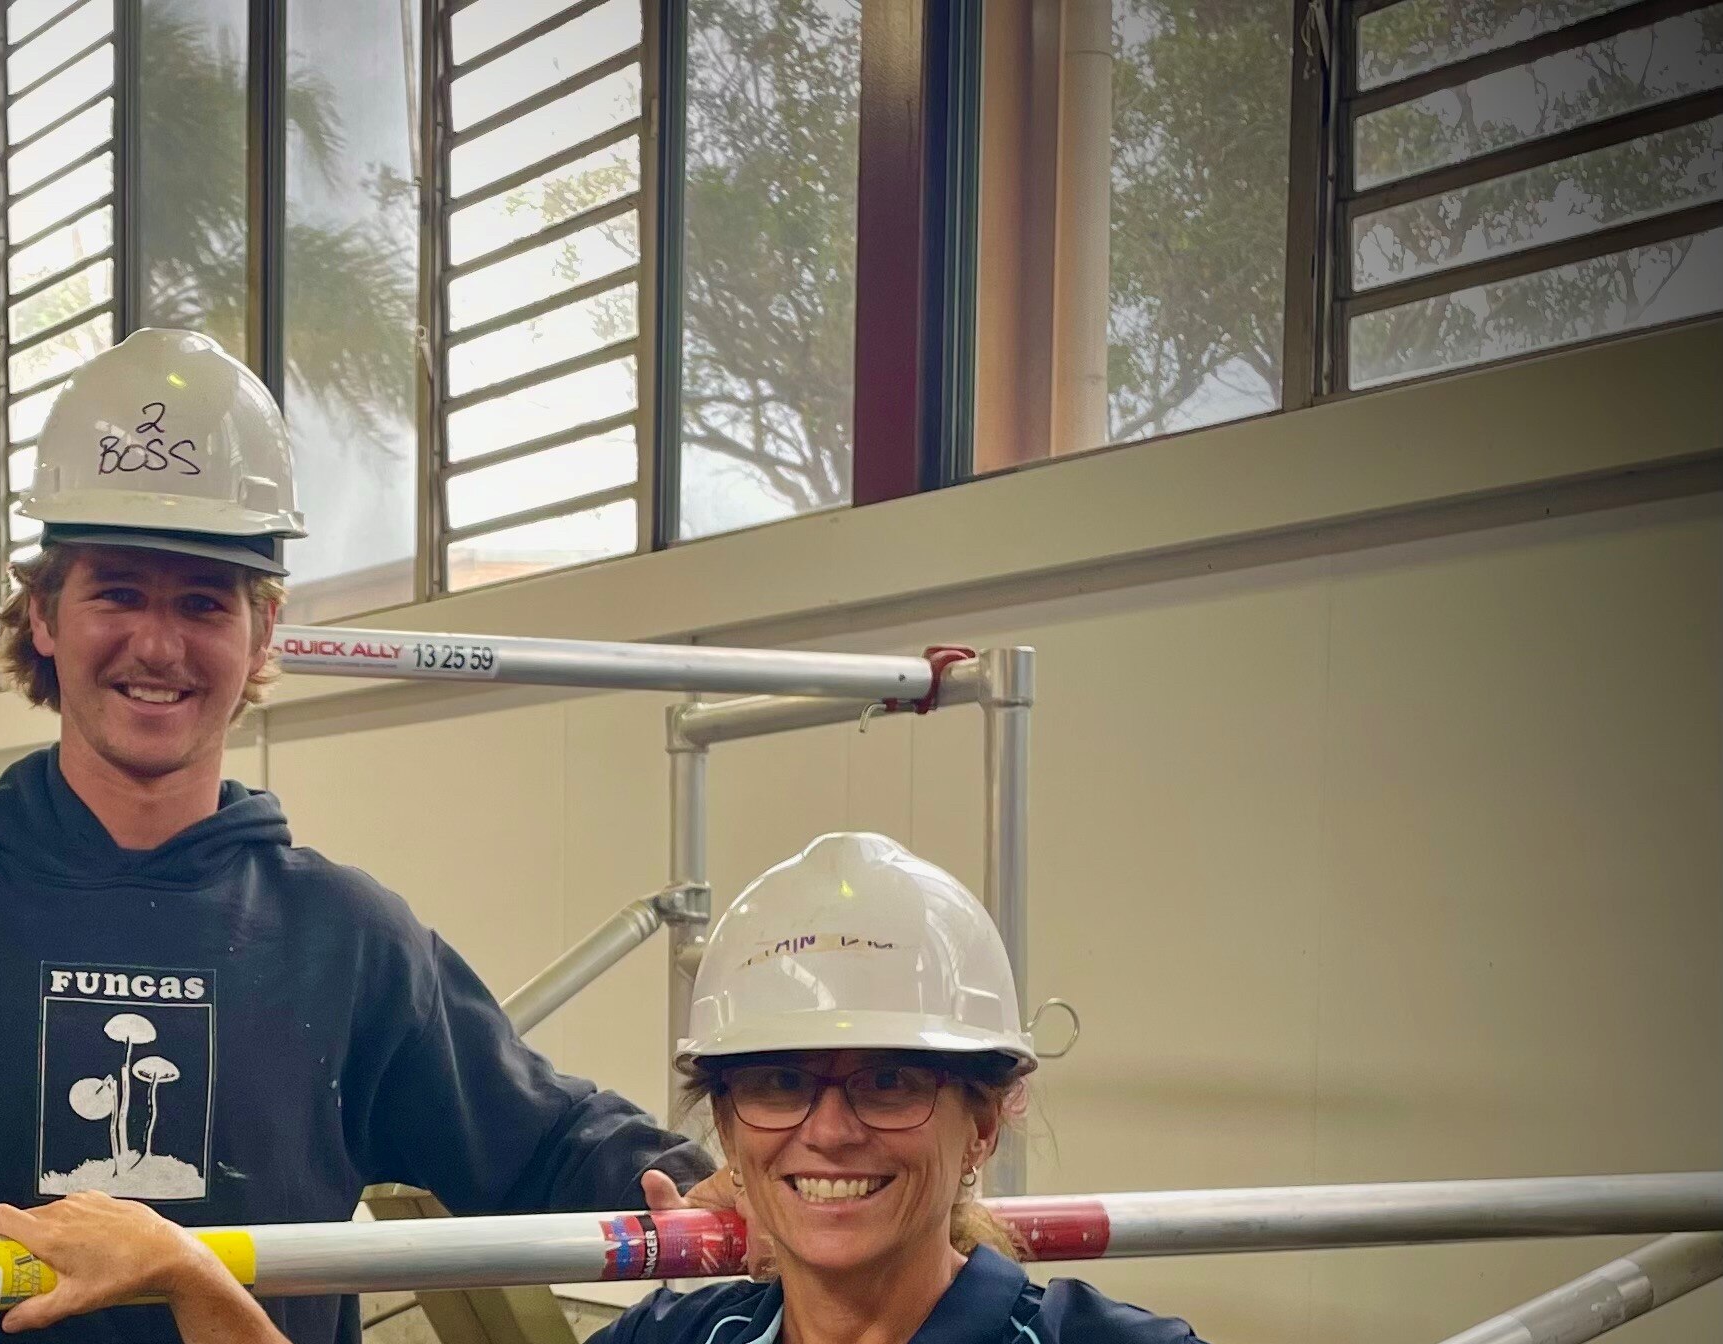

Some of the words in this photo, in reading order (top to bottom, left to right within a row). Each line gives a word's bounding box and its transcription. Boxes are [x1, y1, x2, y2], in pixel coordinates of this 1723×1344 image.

[136, 402, 166, 433] 2
[98, 436, 201, 475] BOSS
[284, 639, 346, 656] QUICK
[350, 640, 404, 659] ALLY
[413, 643, 436, 668] 13
[440, 645, 466, 669] 25
[470, 646, 494, 671] 59
